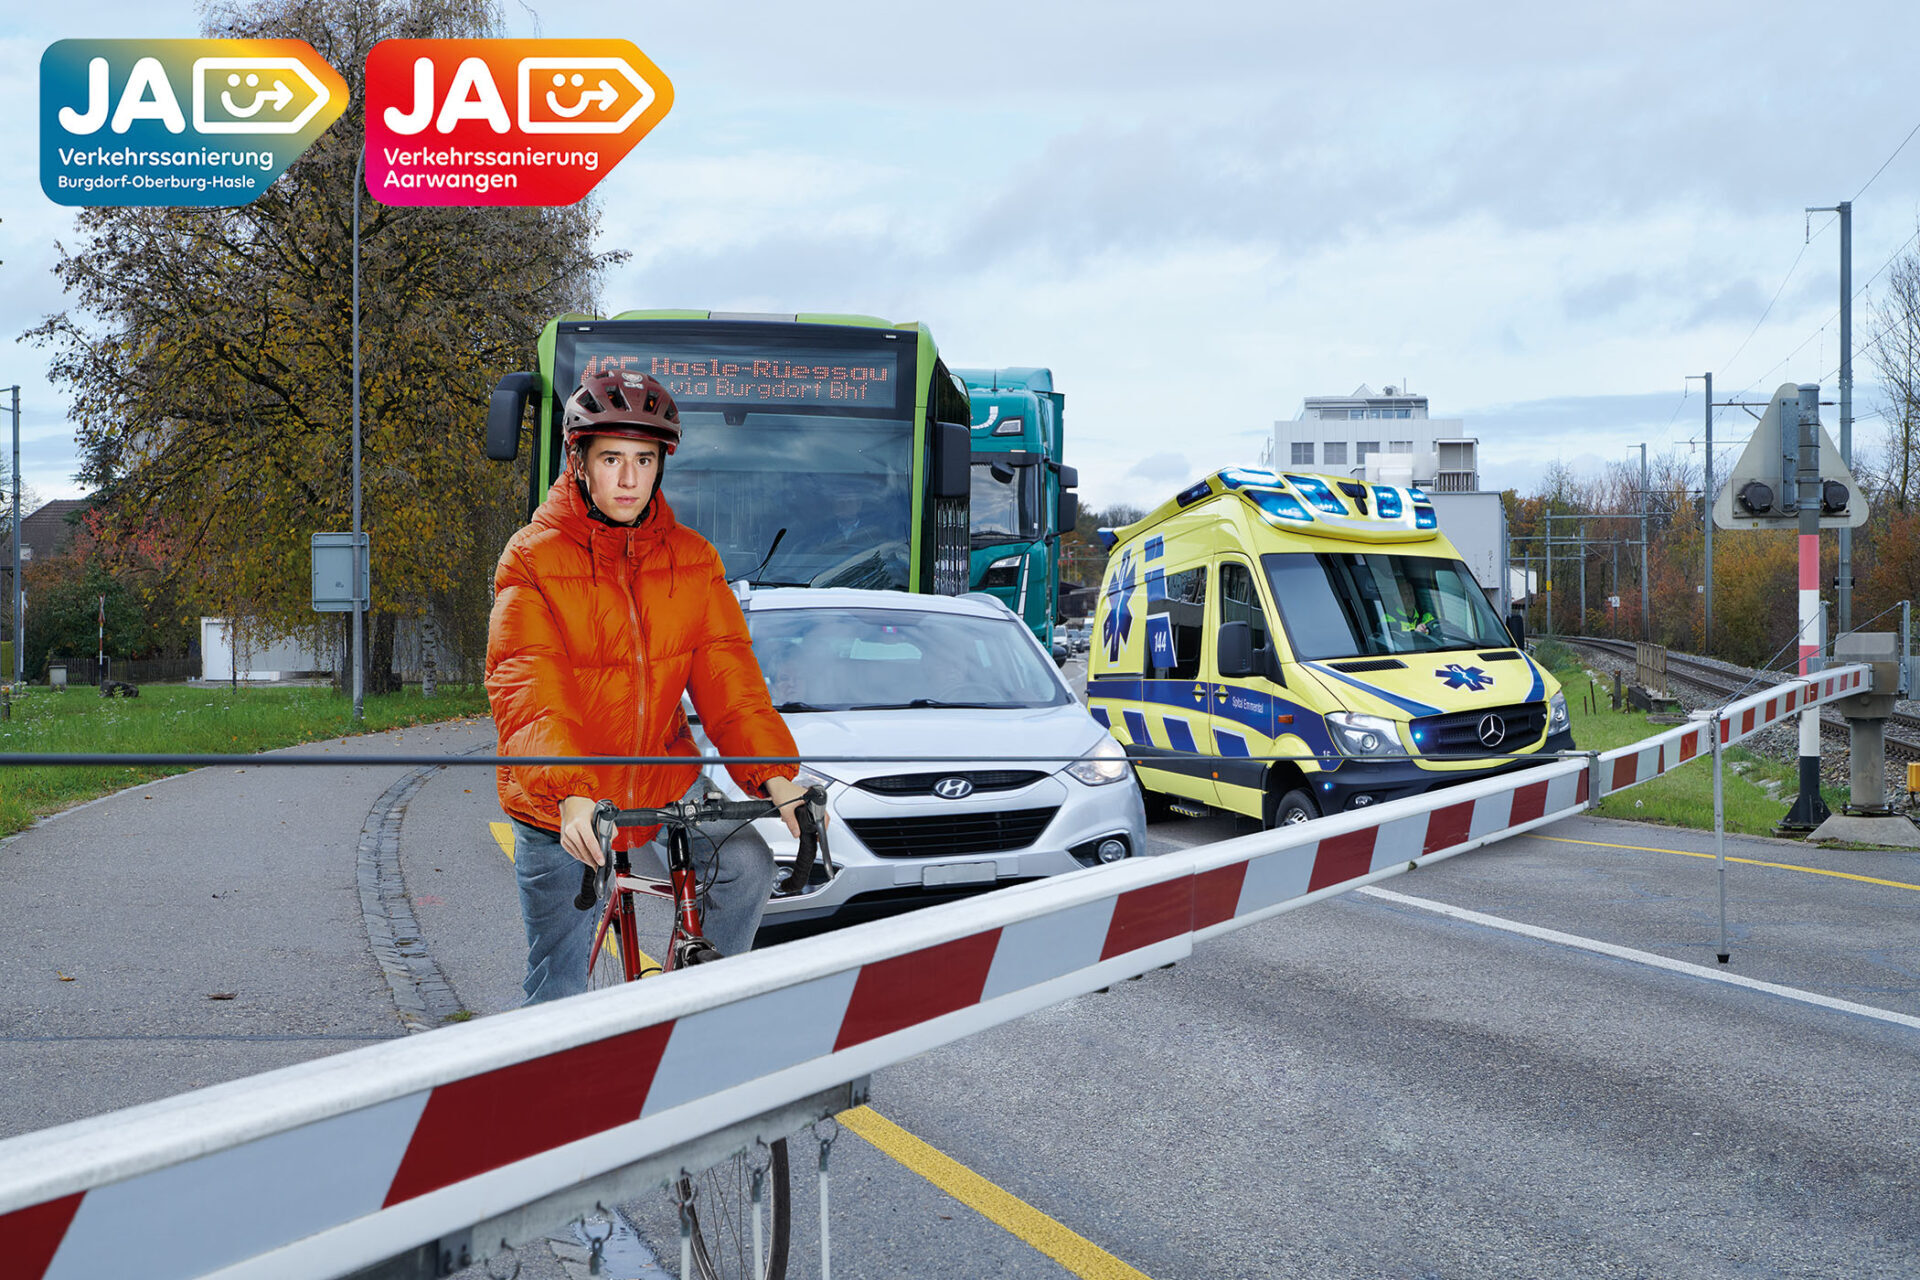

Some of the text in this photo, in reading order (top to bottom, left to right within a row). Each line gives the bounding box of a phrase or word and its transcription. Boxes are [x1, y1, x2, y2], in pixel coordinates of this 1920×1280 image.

[651, 357, 888, 382] Hasle-Rüegsau
[670, 377, 867, 400] via Burgdorf Bhf
[1154, 631, 1167, 652] 144
